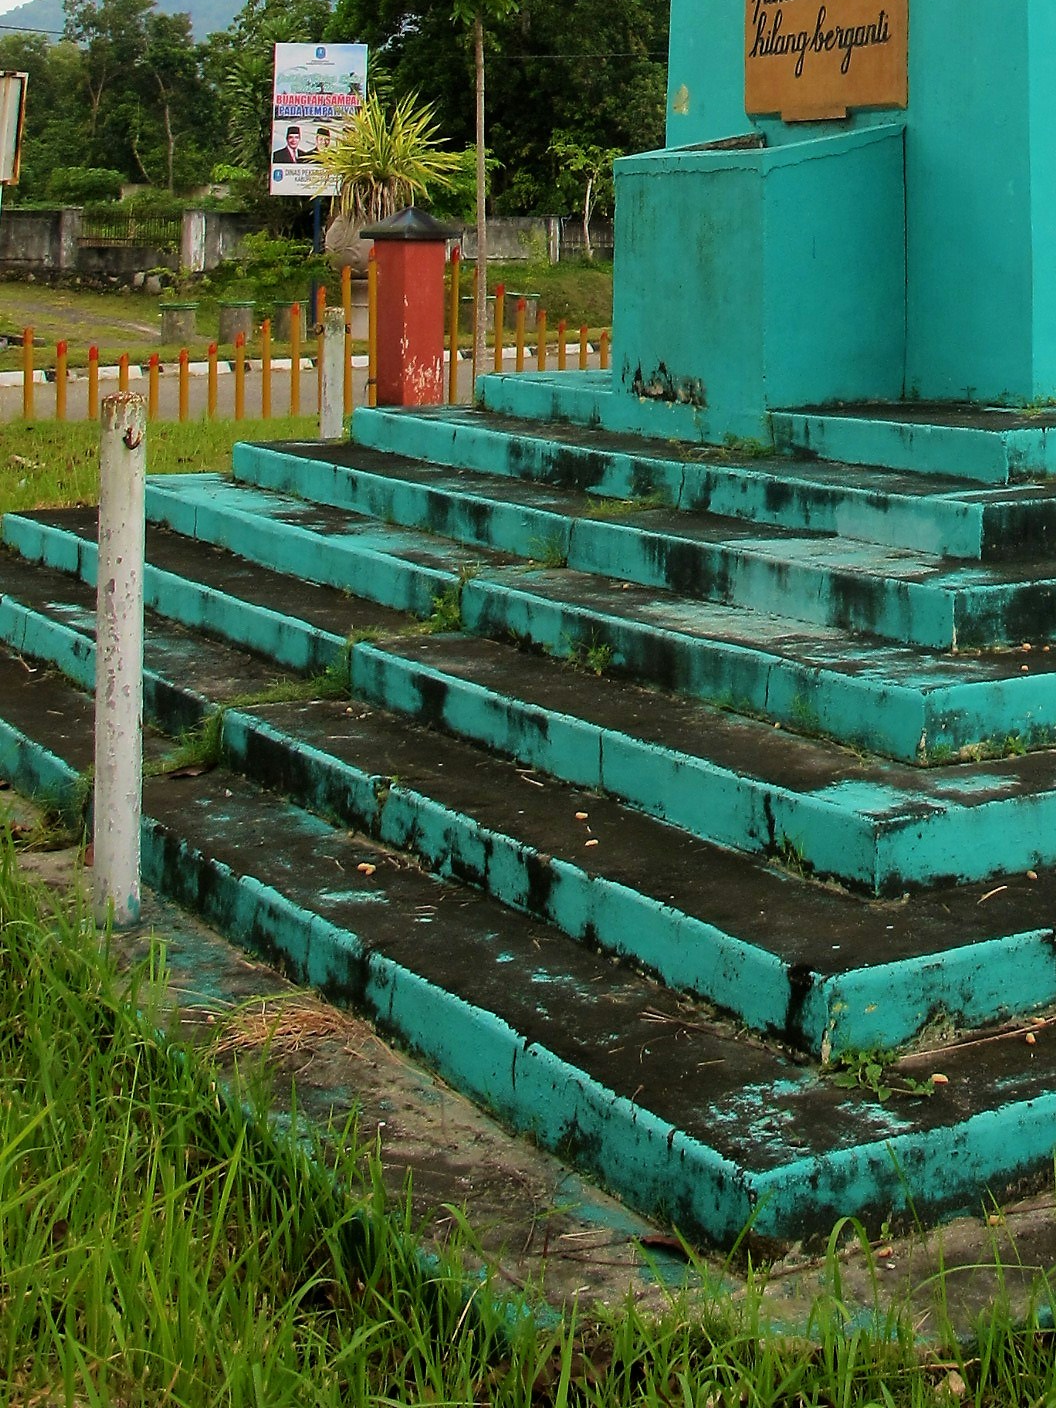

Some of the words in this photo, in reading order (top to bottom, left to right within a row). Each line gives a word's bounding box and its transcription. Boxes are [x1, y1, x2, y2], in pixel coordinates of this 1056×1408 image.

[750, 9, 810, 78] hilang
[809, 5, 891, 74] berganti
[276, 94, 324, 105] BUANGLAH
[279, 106, 303, 116] PADA
